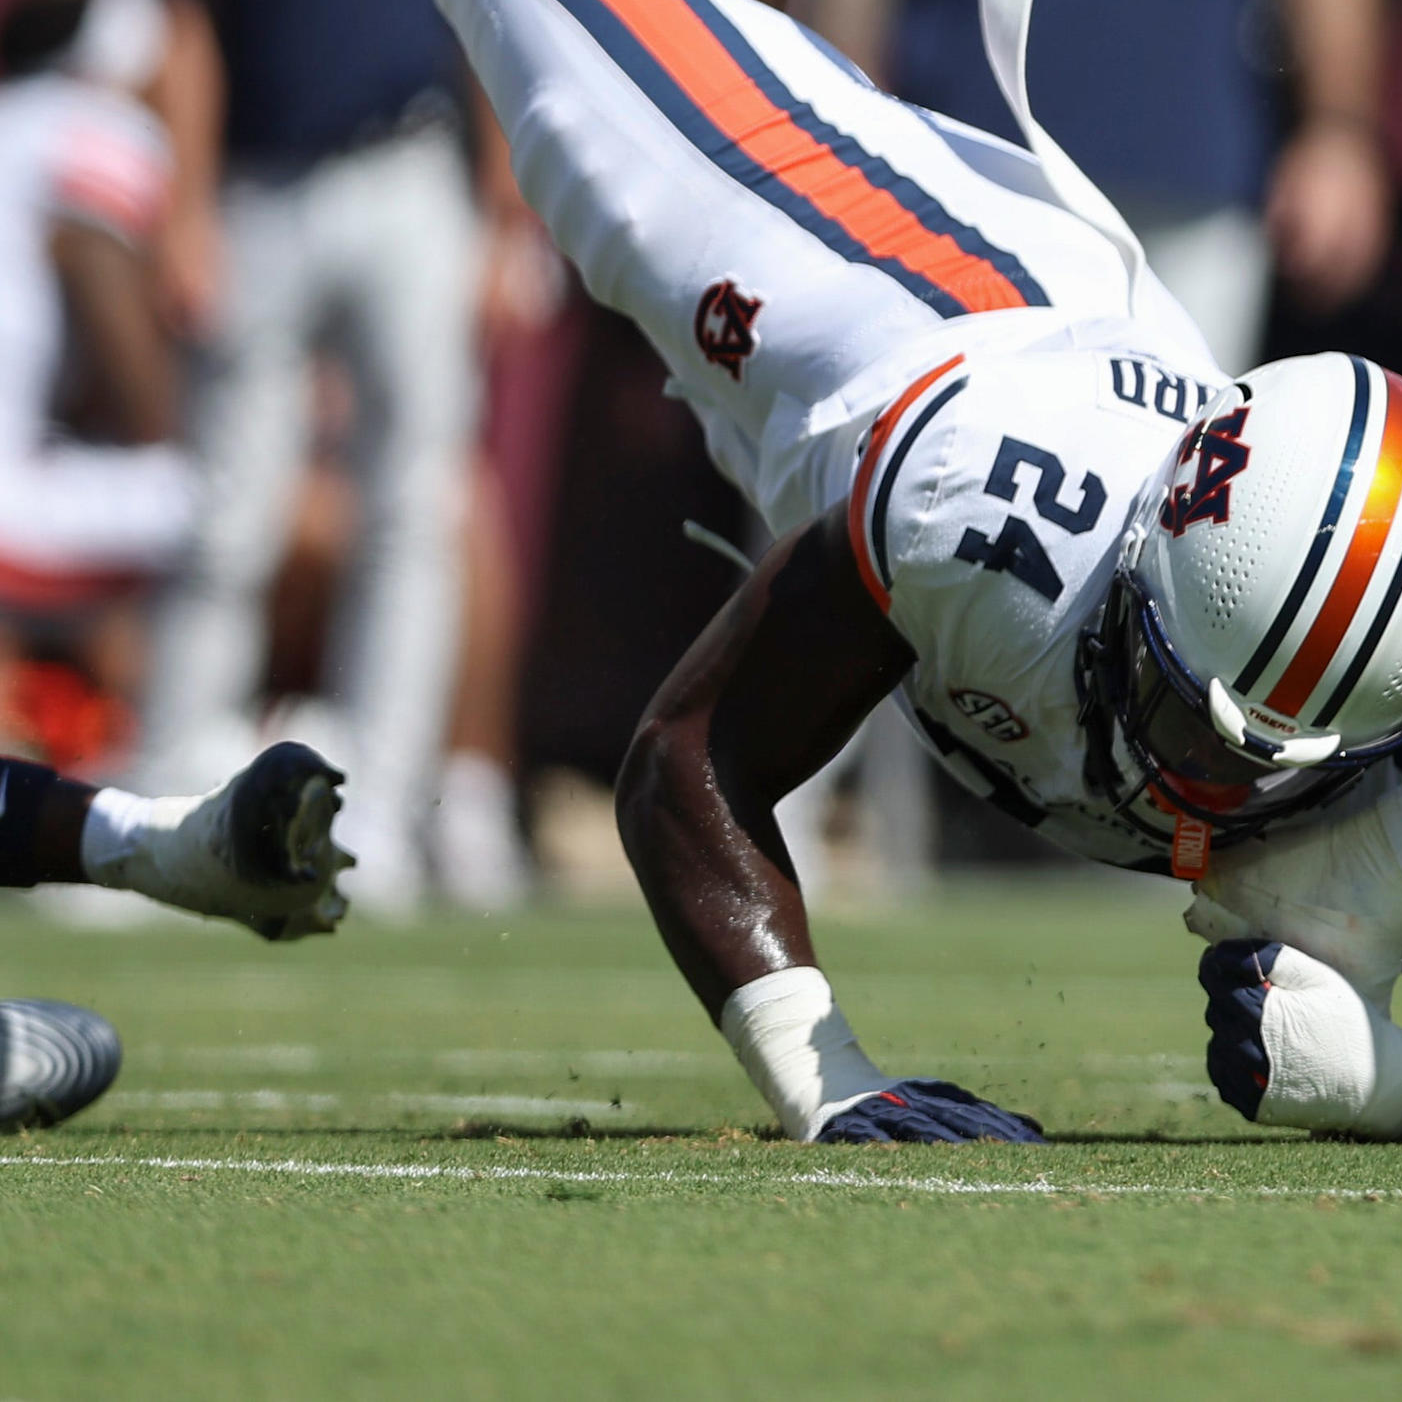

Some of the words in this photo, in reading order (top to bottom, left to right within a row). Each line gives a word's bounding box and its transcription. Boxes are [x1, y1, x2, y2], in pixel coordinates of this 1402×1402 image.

[1110, 359, 1209, 424] RD
[953, 435, 1108, 602] 24
[1248, 707, 1297, 734] TIGERS
